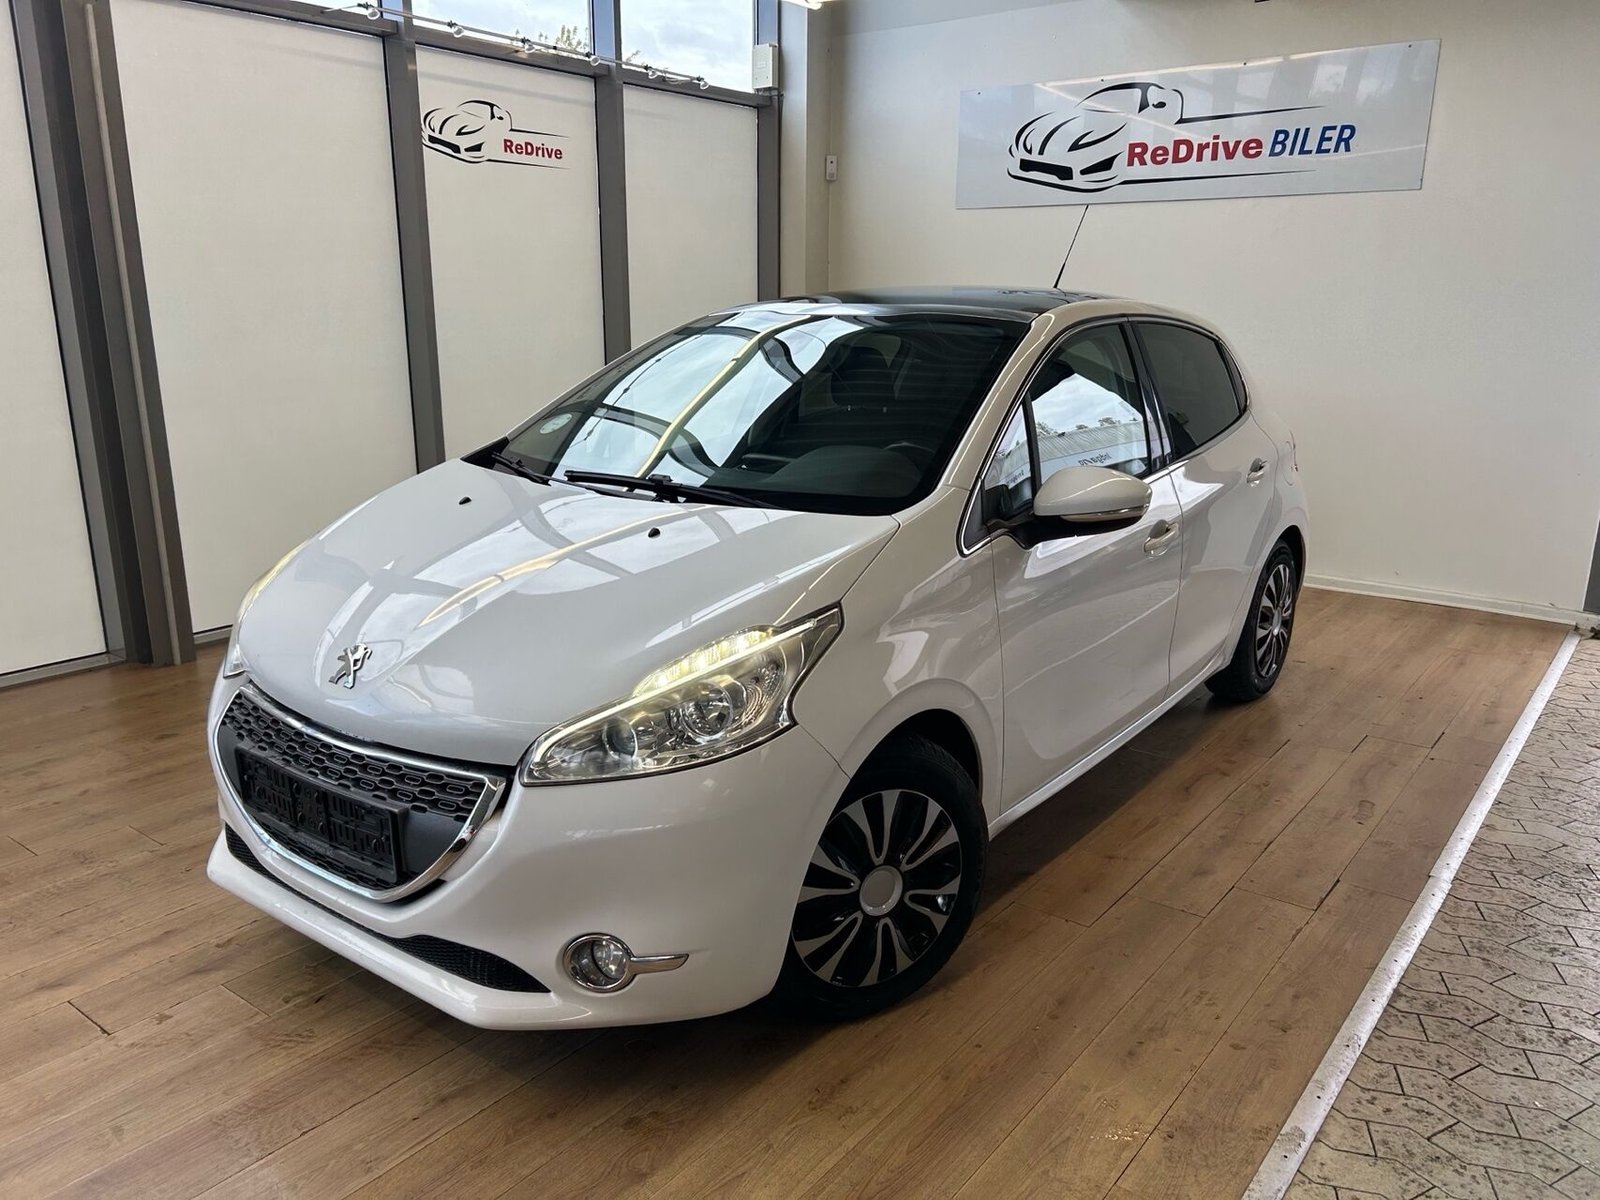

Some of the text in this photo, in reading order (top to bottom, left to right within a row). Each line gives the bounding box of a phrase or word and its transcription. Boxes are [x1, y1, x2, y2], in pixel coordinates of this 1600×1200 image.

[503, 138, 563, 161] ReDrive
[1127, 124, 1357, 167] ReDrive BILER
